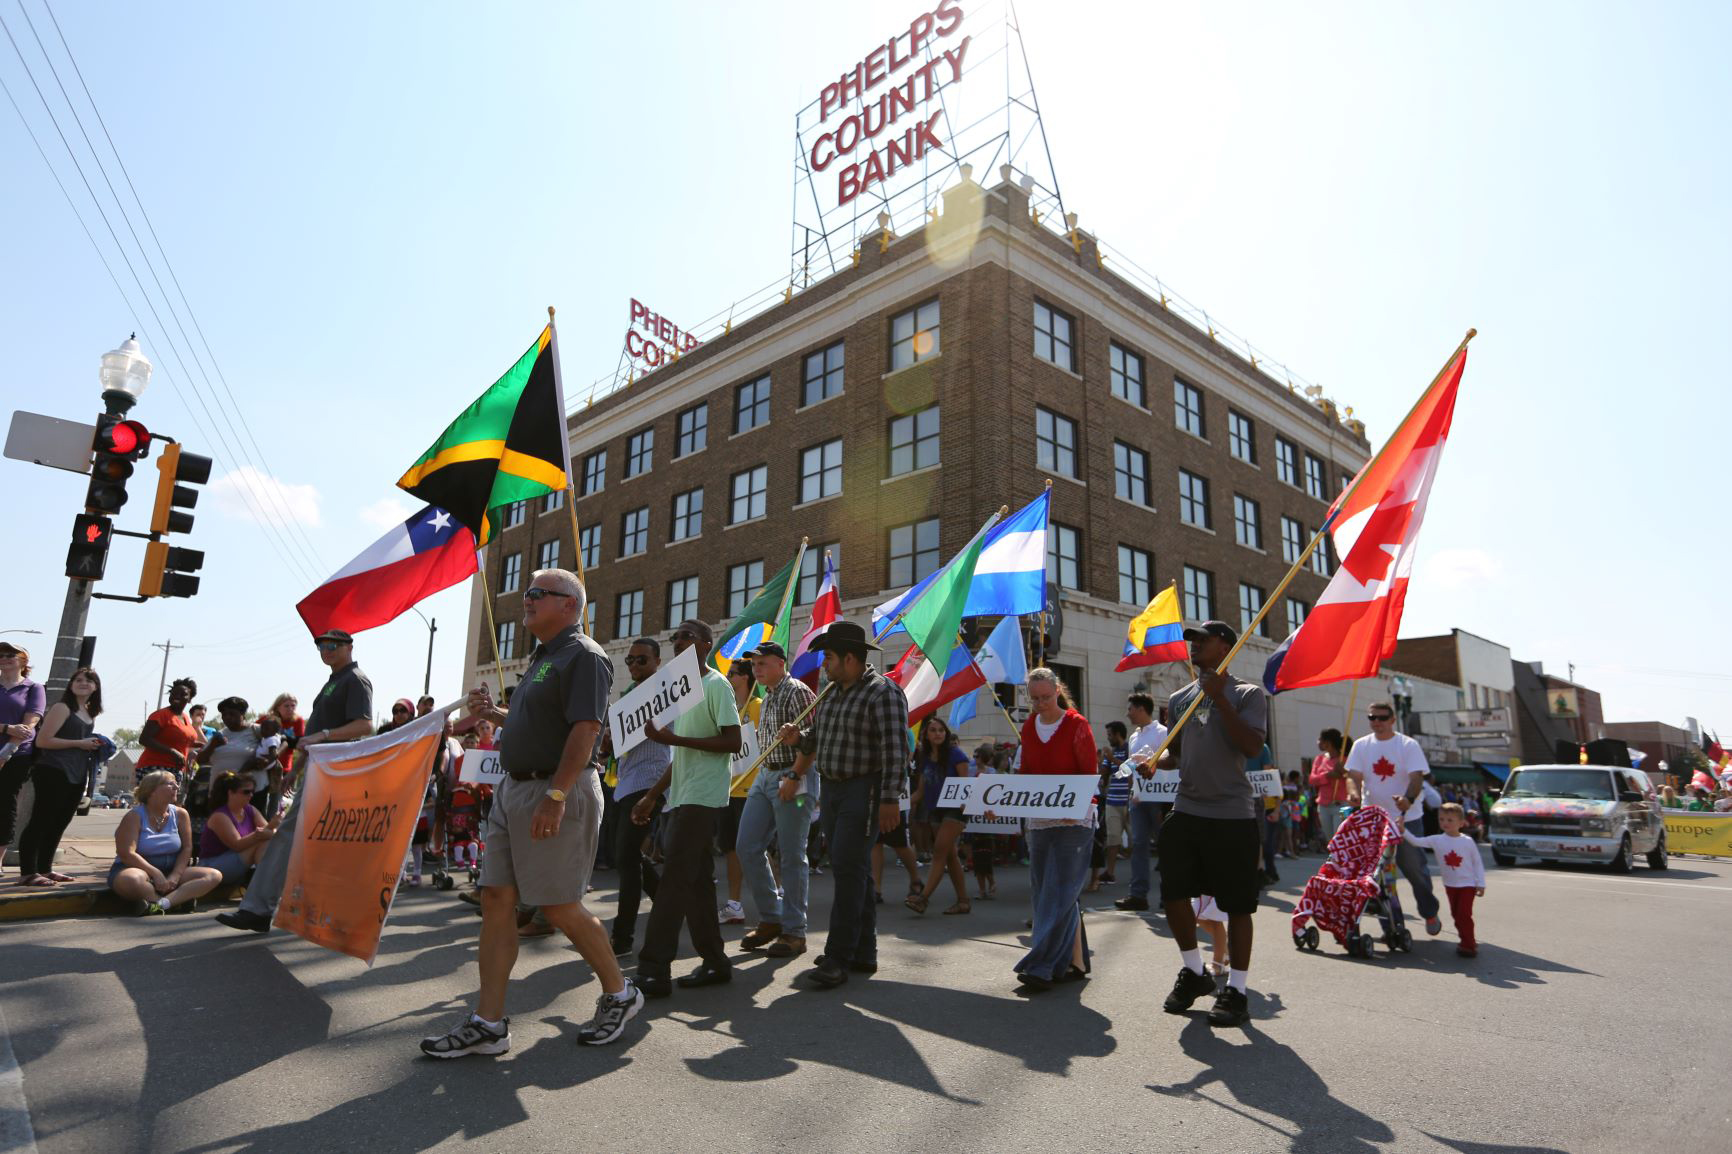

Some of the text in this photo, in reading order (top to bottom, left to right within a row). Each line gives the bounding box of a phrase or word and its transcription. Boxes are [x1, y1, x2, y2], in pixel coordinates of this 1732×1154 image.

[820, 0, 964, 124] PHELPS
[810, 35, 971, 172] COUNTY
[838, 108, 944, 207] BANK
[629, 297, 704, 353] PHELP
[617, 674, 692, 747] Jamaica
[307, 790, 398, 843] Americas
[943, 784, 973, 800] El S
[982, 783, 1077, 808] Canada
